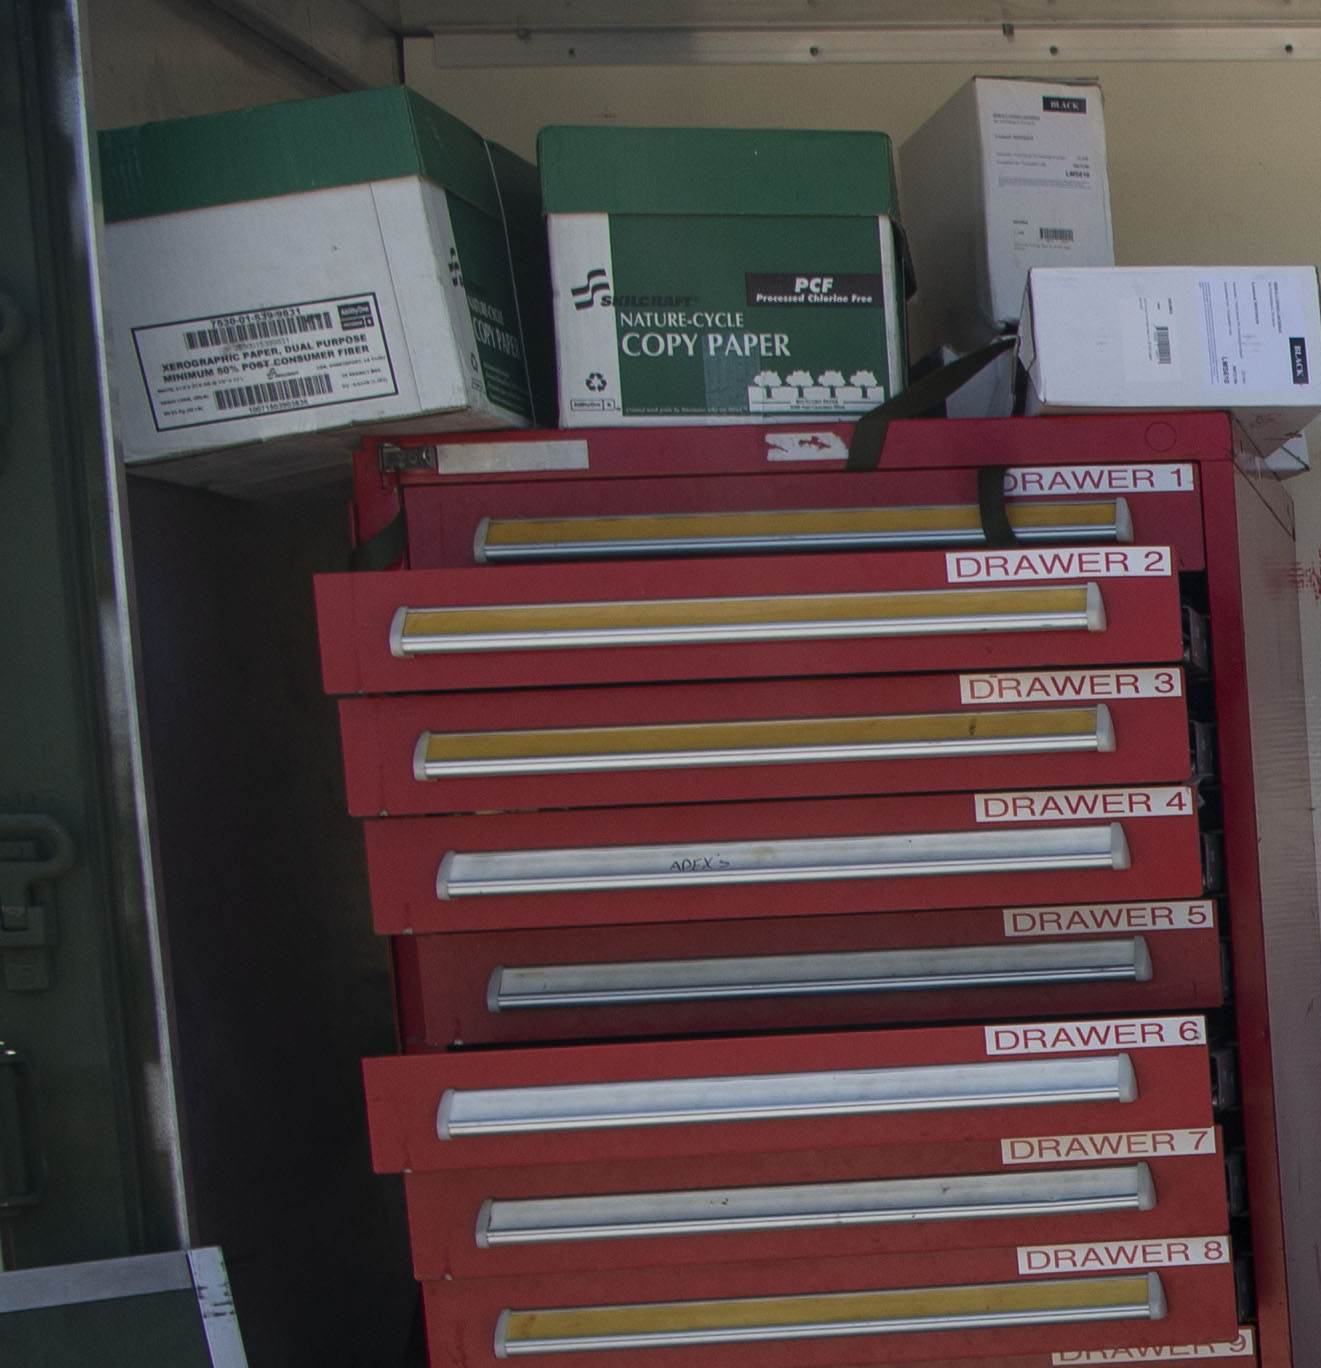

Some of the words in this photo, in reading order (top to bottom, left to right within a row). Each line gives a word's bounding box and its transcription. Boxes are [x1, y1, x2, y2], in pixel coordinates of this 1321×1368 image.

[1050, 100, 1080, 110] BLACK
[755, 293, 805, 303] Processed
[807, 293, 849, 303] Chlorine
[851, 293, 873, 303] Free
[794, 276, 834, 294] PCF
[620, 312, 745, 328] NATURE-CYCLE
[161, 353, 240, 373] XEROGRAPHIC
[284, 341, 314, 354] DUAL
[316, 333, 367, 347] PURPOSE
[621, 333, 699, 357] COPY
[706, 333, 792, 357] PAPER
[162, 368, 215, 384] MINIMUM
[241, 359, 271, 372] POST
[273, 350, 336, 367] CONSUMER
[337, 345, 370, 356] FIBER
[1293, 345, 1305, 377] BLACK
[1004, 467, 1155, 492] DRAWER
[1170, 467, 1184, 488] 1
[955, 551, 1130, 578] DRAWER
[1144, 551, 1165, 572] 2
[969, 673, 1141, 700] DRAWER
[1154, 672, 1175, 694] 3
[983, 792, 1153, 818] DRAWER
[1165, 791, 1188, 811] 4
[1011, 905, 1175, 933] DRAWER
[1187, 905, 1207, 925] 5
[994, 1021, 1166, 1051] DRAWER
[1178, 1020, 1200, 1041] 6
[1009, 1131, 1176, 1160] DRAWER
[1187, 1130, 1209, 1151] 7
[1026, 1242, 1190, 1271] DRAWER
[1203, 1240, 1224, 1261] 8
